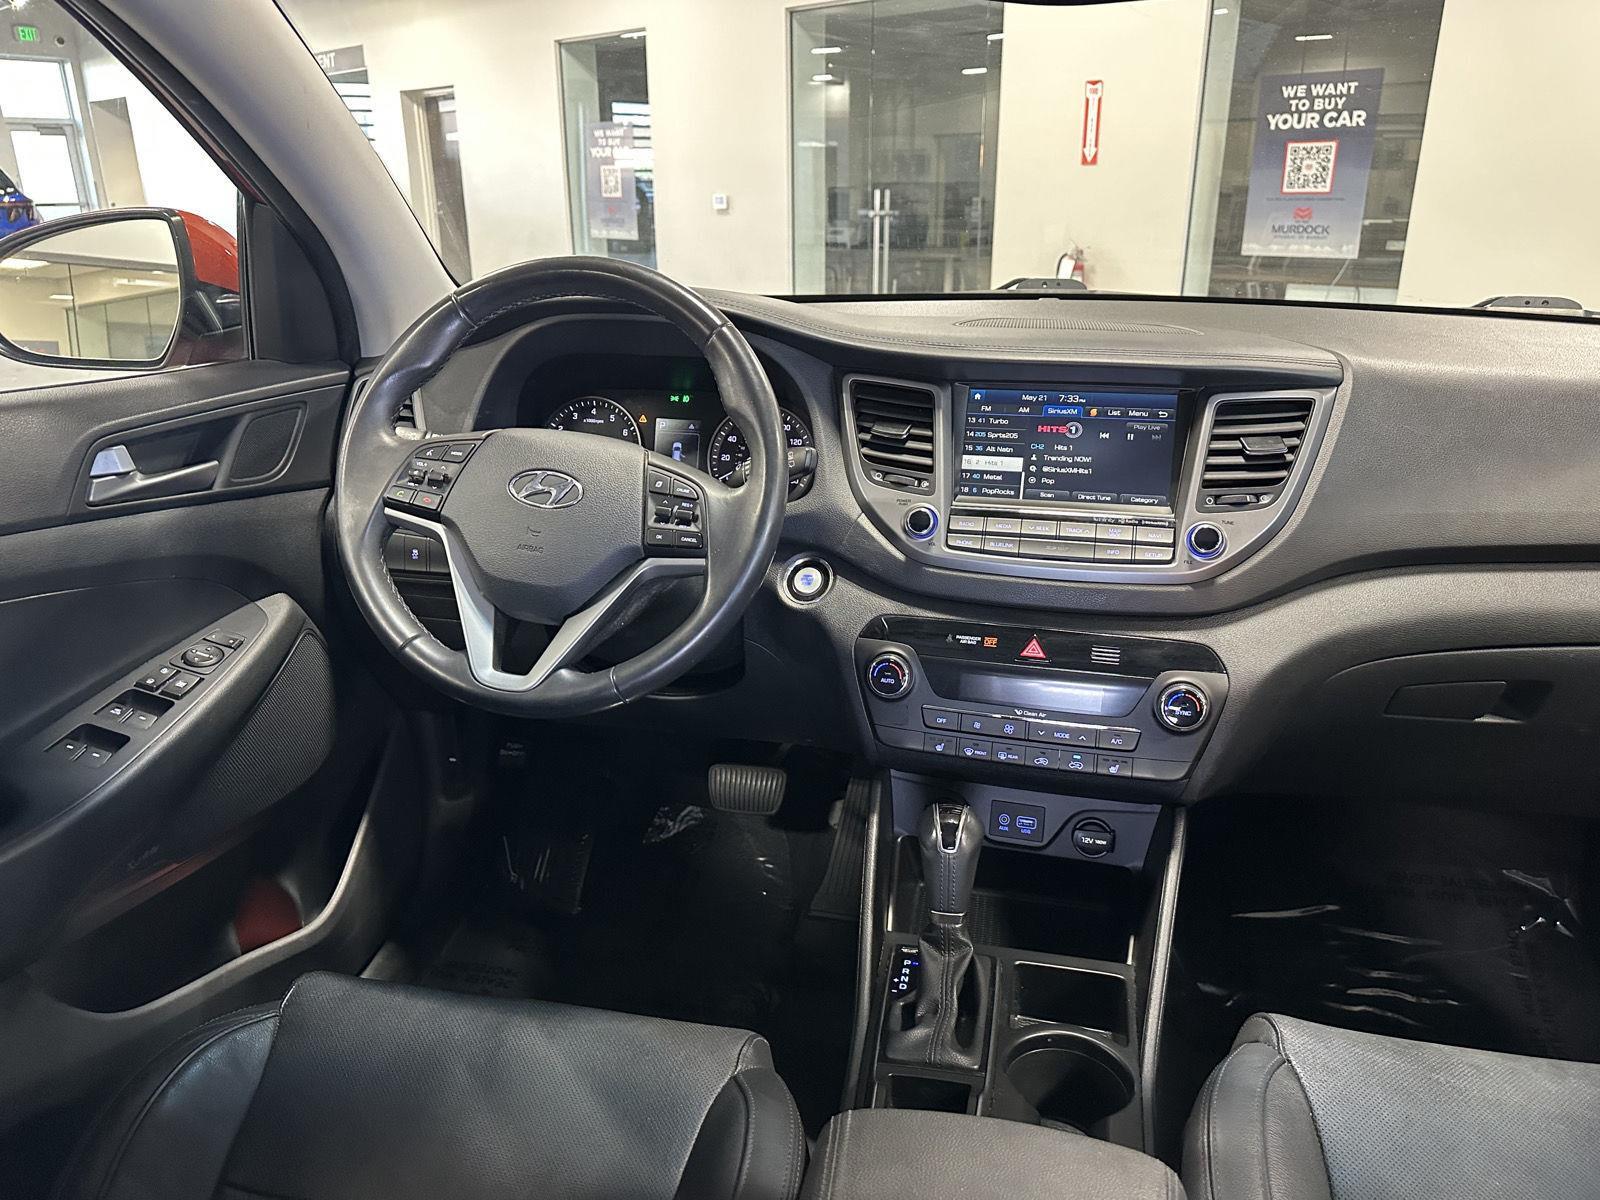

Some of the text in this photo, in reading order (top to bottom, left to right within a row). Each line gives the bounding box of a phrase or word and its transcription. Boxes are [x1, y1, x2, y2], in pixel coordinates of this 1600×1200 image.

[1281, 82, 1359, 98] WE WANT
[1289, 97, 1347, 112] TO BUY
[1267, 110, 1367, 131] YOUR CAR
[1271, 224, 1330, 235] MURDOCK
[1021, 394, 1038, 402] May
[1059, 394, 1080, 403] 7:33
[1047, 407, 1078, 416] SiriusXM
[572, 412, 578, 420] 3
[609, 414, 615, 422] 5
[622, 428, 628, 436] 6
[1037, 425, 1069, 434] HITS
[727, 435, 737, 443] 40
[987, 431, 1019, 439] Sprts205
[789, 438, 803, 446] 120
[1044, 454, 1073, 463] Trending
[981, 487, 1015, 496] PopRocks
[1130, 496, 1159, 504] Category
[1023, 709, 1038, 717] Clean
[1081, 836, 1094, 845] 12V
[902, 967, 910, 975] R
[900, 975, 909, 983] N
